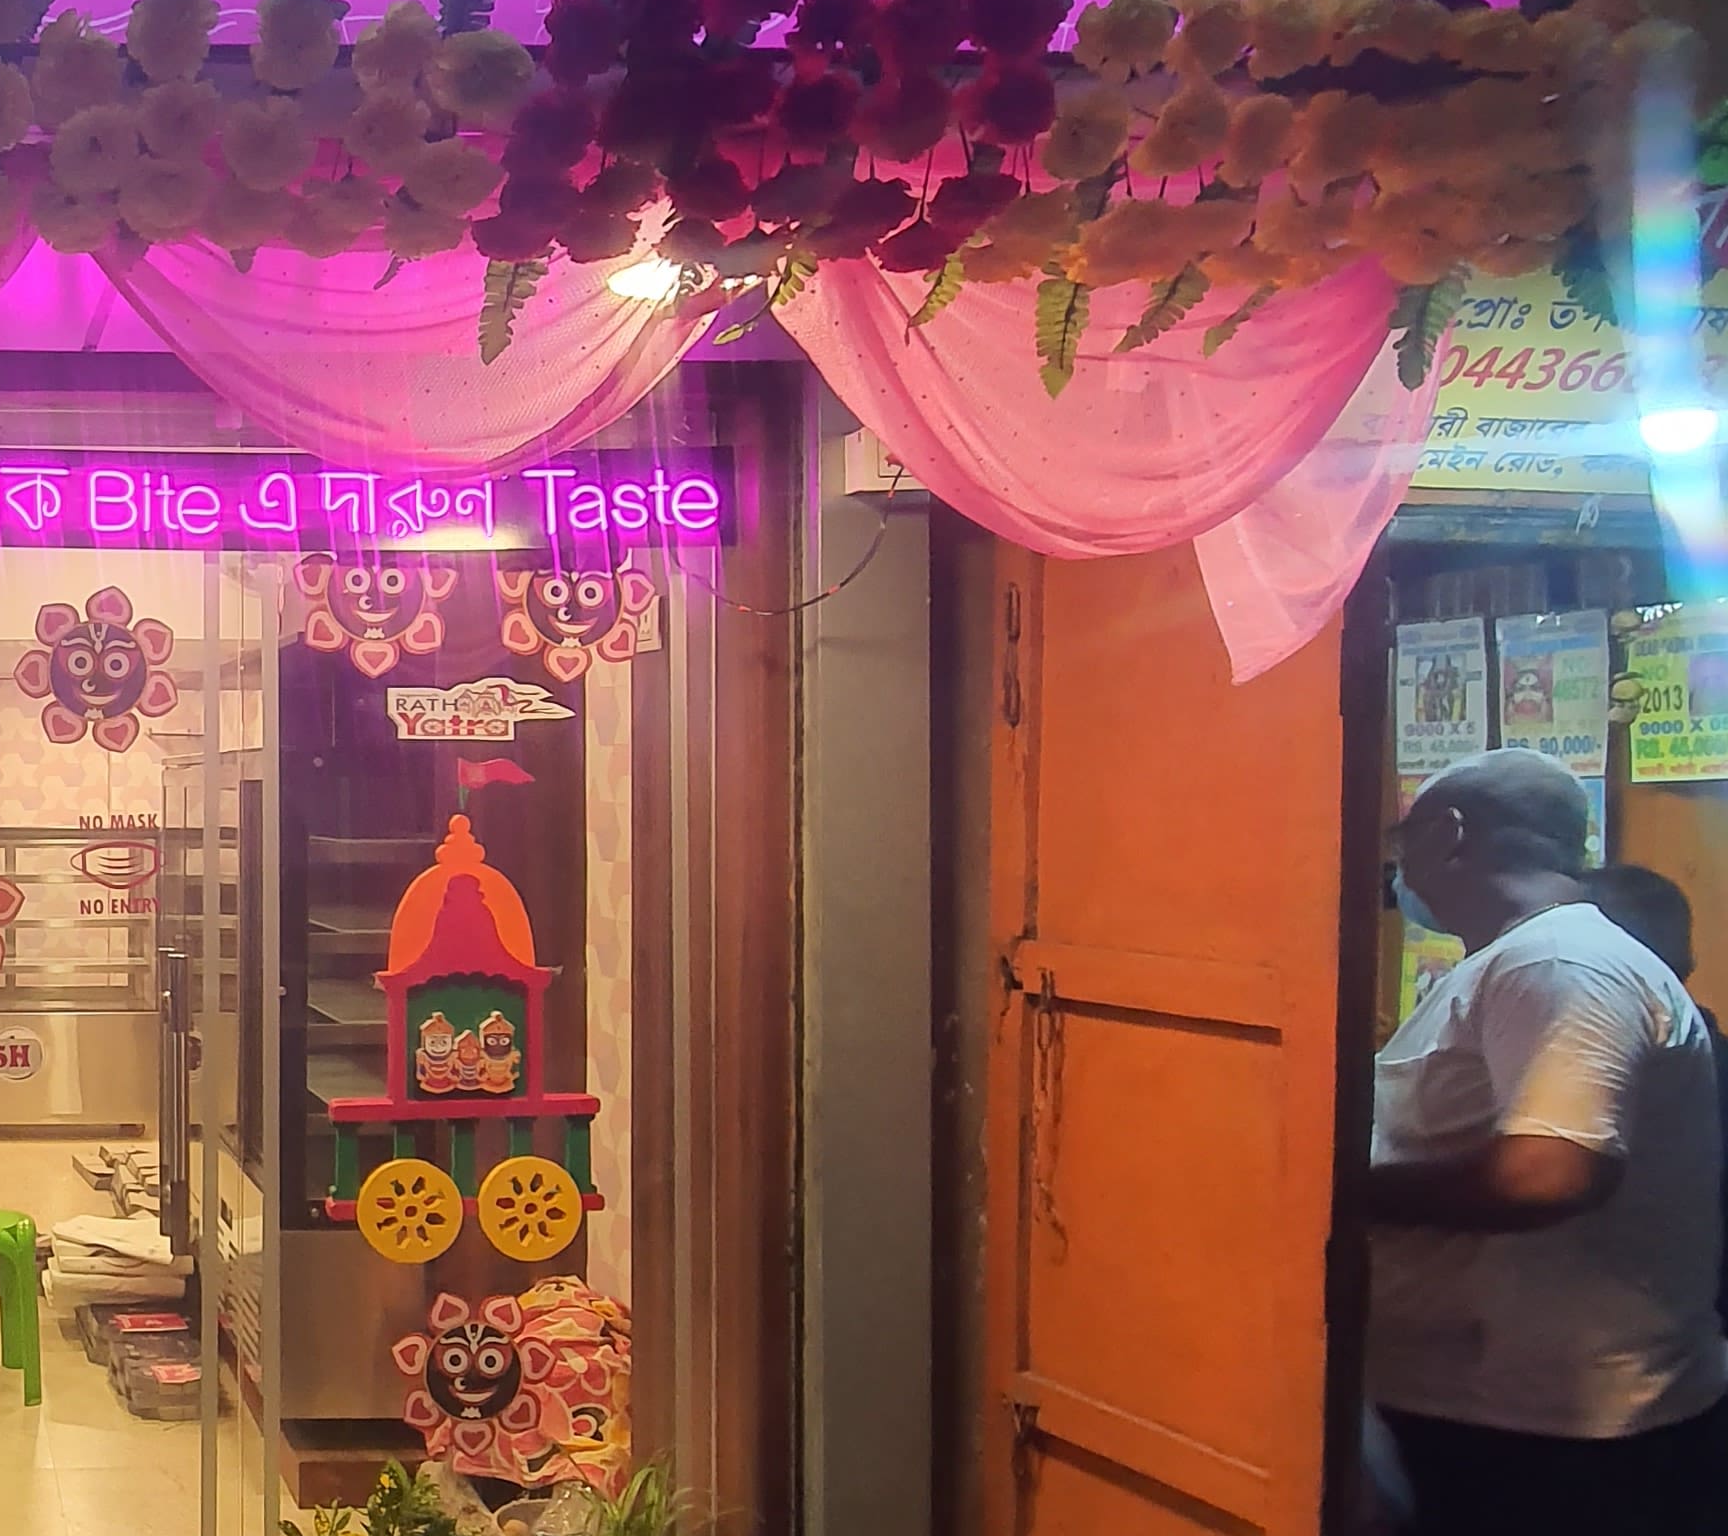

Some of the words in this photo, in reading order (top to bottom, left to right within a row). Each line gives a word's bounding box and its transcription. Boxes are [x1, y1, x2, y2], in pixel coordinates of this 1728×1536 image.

[89, 470, 221, 534] Bite
[239, 472, 297, 532] এ
[520, 467, 720, 536] Taste
[396, 698, 458, 711] RATH
[1642, 685, 1684, 714] 2013
[398, 712, 509, 736] Yatra
[79, 815, 103, 831] NO
[111, 813, 160, 830] MASK
[80, 899, 104, 915] NO
[111, 897, 161, 914] ENTRY
